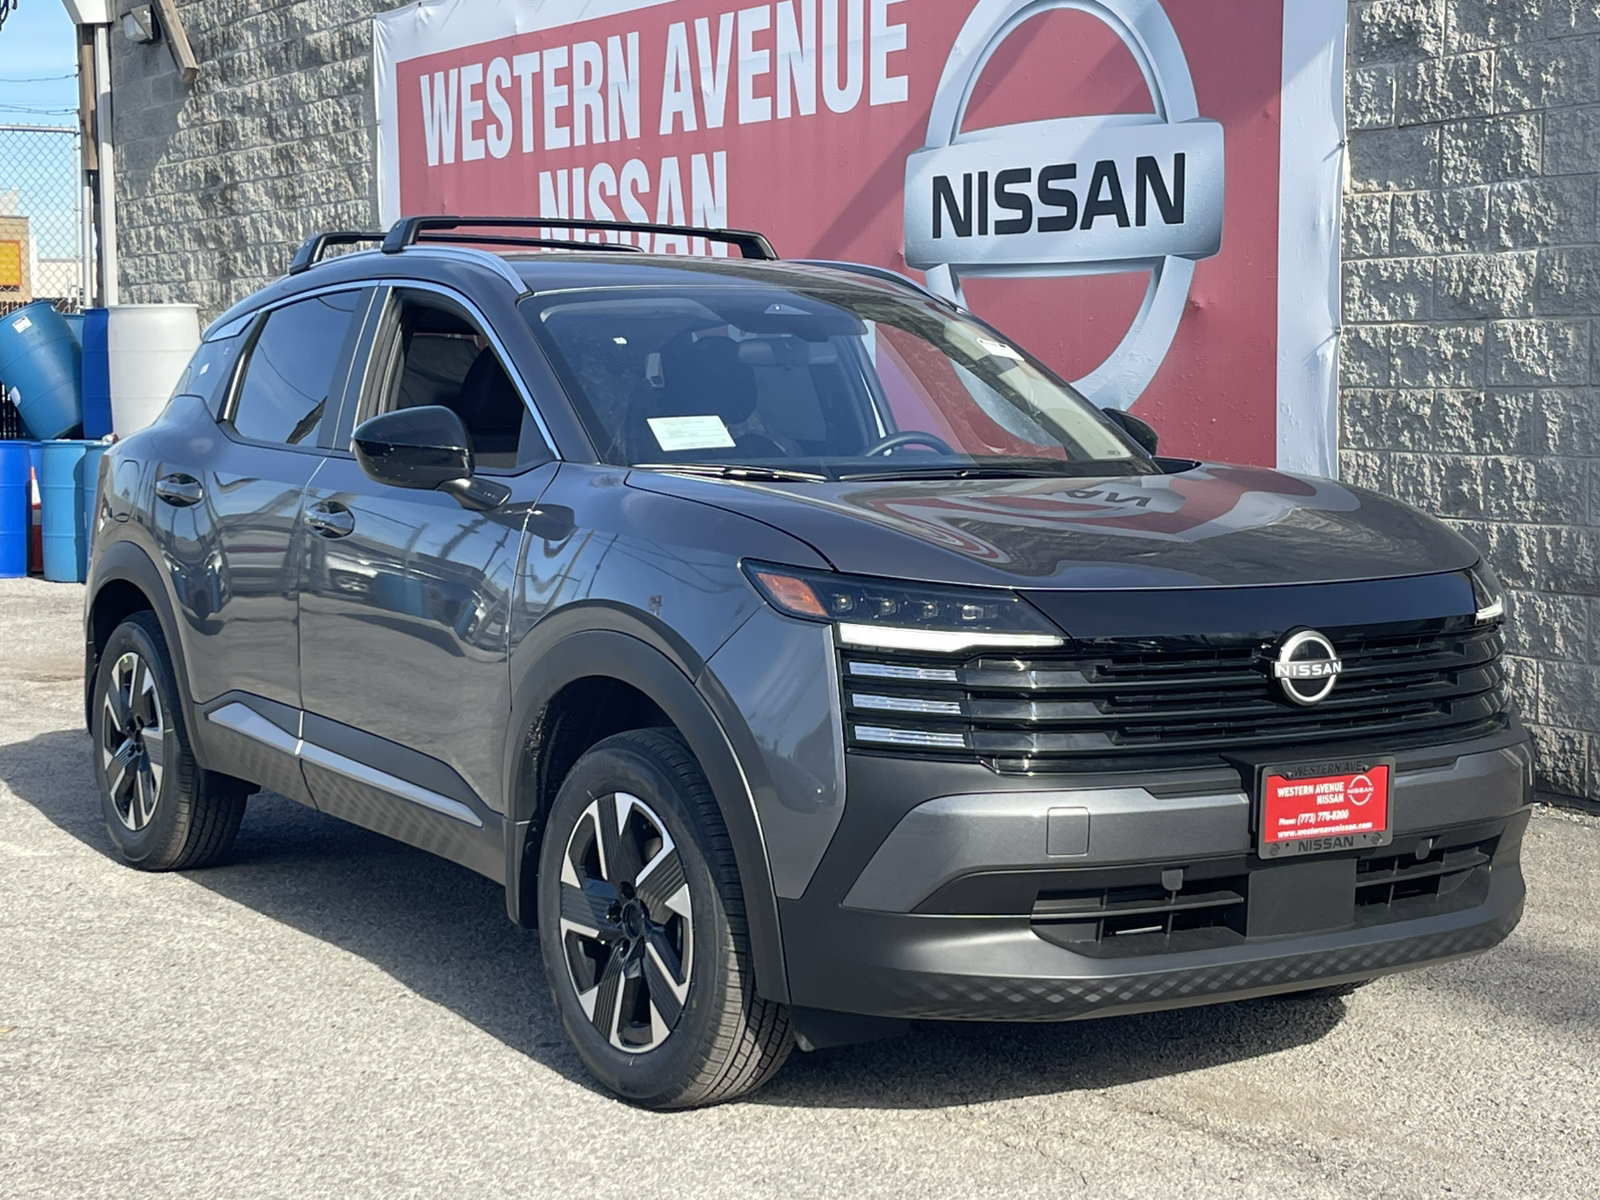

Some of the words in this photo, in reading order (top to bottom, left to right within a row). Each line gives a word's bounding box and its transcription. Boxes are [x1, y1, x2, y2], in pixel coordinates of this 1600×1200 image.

[420, 31, 640, 167] WESTERN
[659, 0, 909, 135] AVENUE
[932, 152, 1186, 239] NISSAN
[539, 151, 728, 258] NISSAN
[1277, 661, 1342, 676] NISSAN
[1295, 764, 1340, 777] WESTERN
[1344, 761, 1362, 773] AVE
[1277, 785, 1314, 798] WESTERN
[1315, 782, 1345, 794] AVENUE
[1347, 787, 1374, 795] NISSAN
[1316, 793, 1344, 805] NISSAN
[1297, 812, 1316, 826] (773)
[1298, 836, 1354, 852] NISSAN
